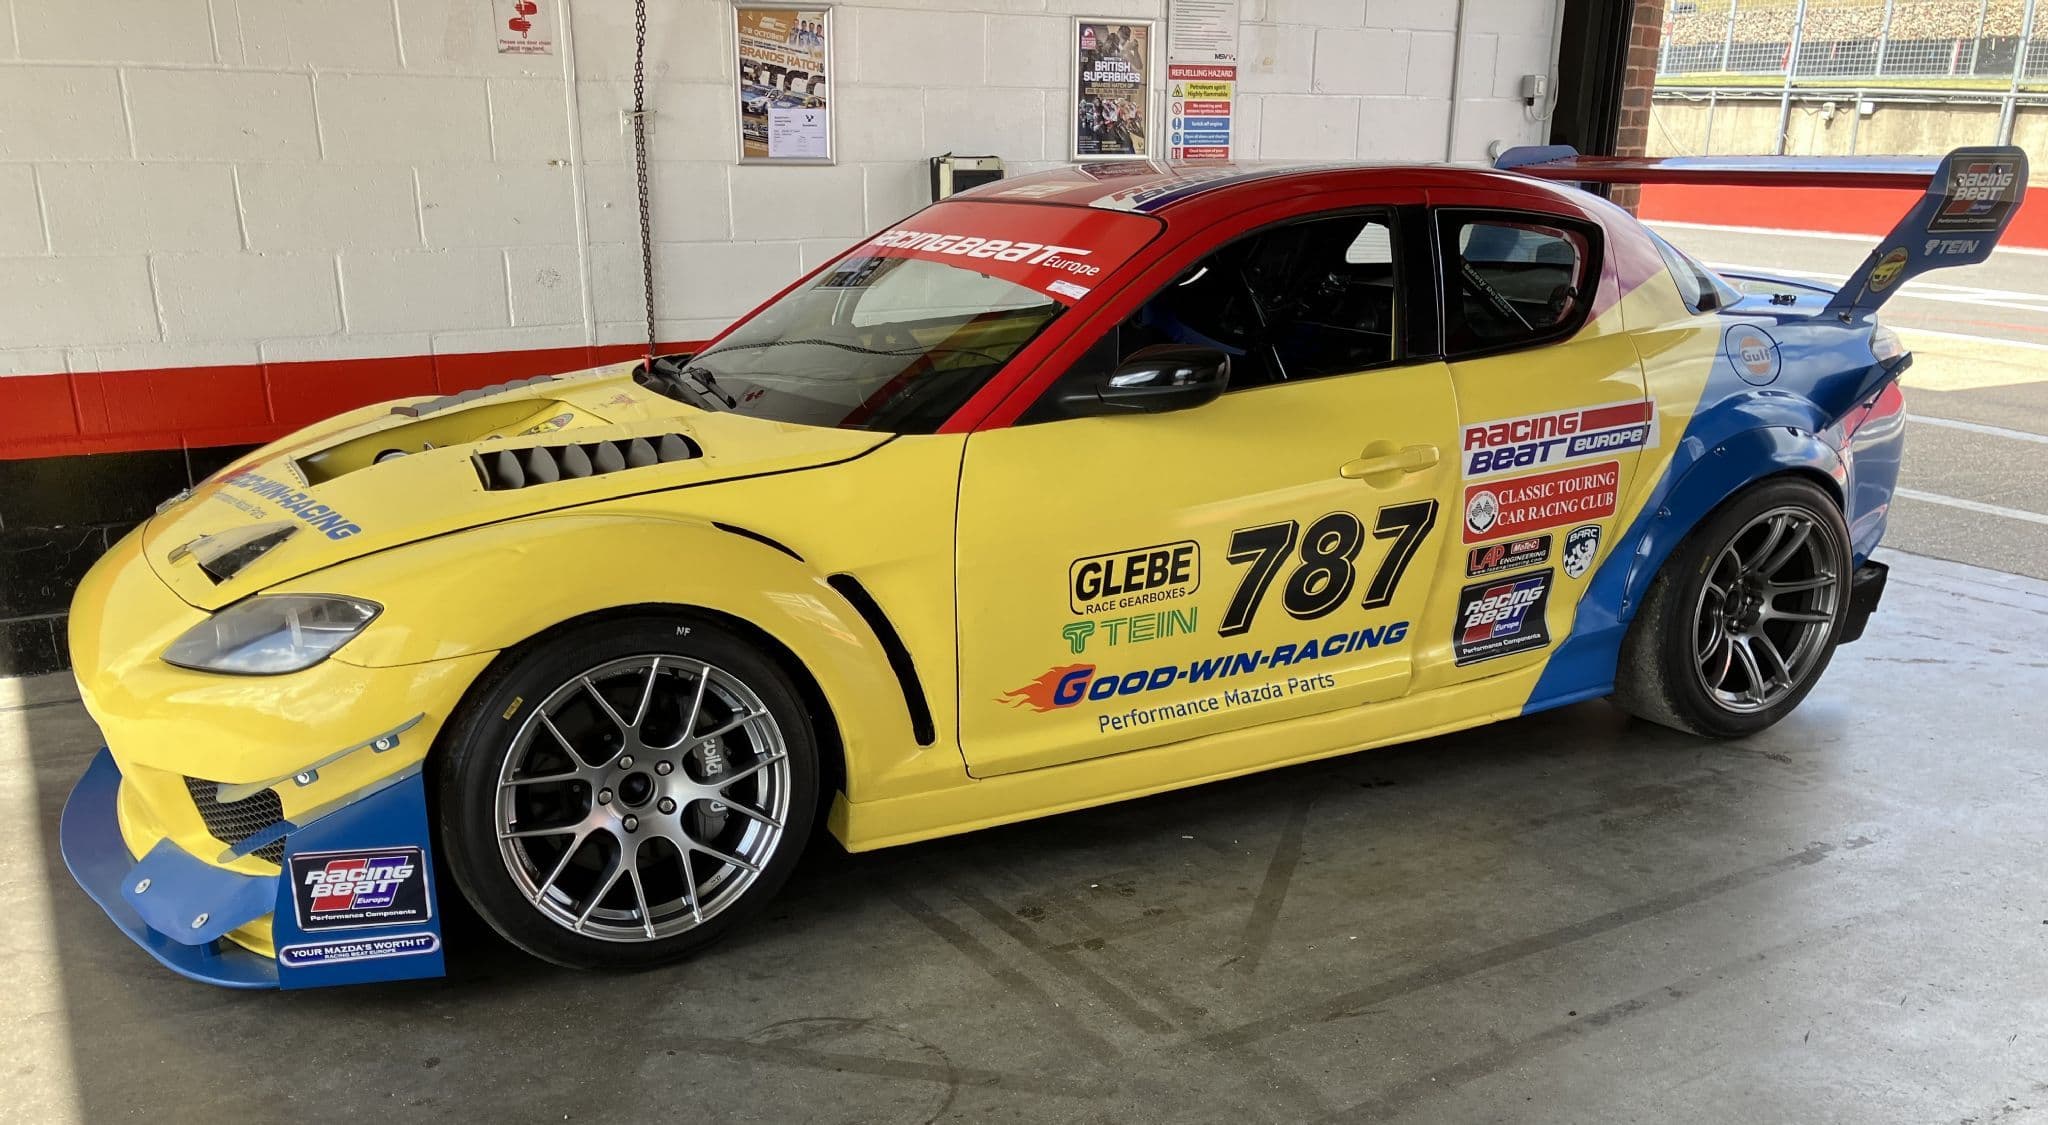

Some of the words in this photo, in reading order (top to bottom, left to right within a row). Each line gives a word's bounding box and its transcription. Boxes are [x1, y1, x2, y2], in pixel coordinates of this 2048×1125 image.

[740, 46, 785, 64] BRANDS
[786, 55, 821, 71] HATCH
[1094, 60, 1131, 72] BRITISH
[1083, 71, 1141, 83] SUPERBIKES
[1171, 69, 1207, 77] REFUELLING
[1208, 69, 1234, 78] HAZARD
[1939, 239, 1980, 254] TEIN
[1043, 254, 1100, 277] Europe
[1463, 263, 1487, 288] Safety
[1741, 348, 1770, 362] Gulf
[1498, 482, 1555, 506] CLASSIC
[1557, 471, 1616, 495] TOURING
[1497, 508, 1525, 527] CAR
[1527, 498, 1578, 521] RACING
[1580, 491, 1614, 511] CLUB
[1569, 527, 1598, 543] BARC
[1217, 497, 1440, 638] 787
[1470, 543, 1506, 572] LAP
[1499, 549, 1547, 565] ENGINEERING
[1075, 545, 1194, 602] GLEBE
[1085, 600, 1117, 615] RACE
[1119, 587, 1187, 609] GEARBOXES
[1100, 606, 1198, 647] TEIN
[1494, 621, 1520, 632] Europe
[1462, 640, 1503, 655] Performance
[1503, 633, 1542, 646] Components
[1053, 620, 1410, 706] GOOD-WIN-RACING
[1098, 696, 1219, 733] Performance
[1224, 682, 1284, 708] Mazda
[1287, 672, 1335, 695] Parts
[356, 896, 391, 905] Europe
[310, 912, 365, 921] Performance
[365, 909, 417, 918] Components
[291, 948, 322, 958] YOUR
[324, 943, 372, 955] MAZDA'S
[373, 939, 414, 950] WORTH
[324, 952, 350, 960] RACING
[351, 950, 369, 959] BEAT
